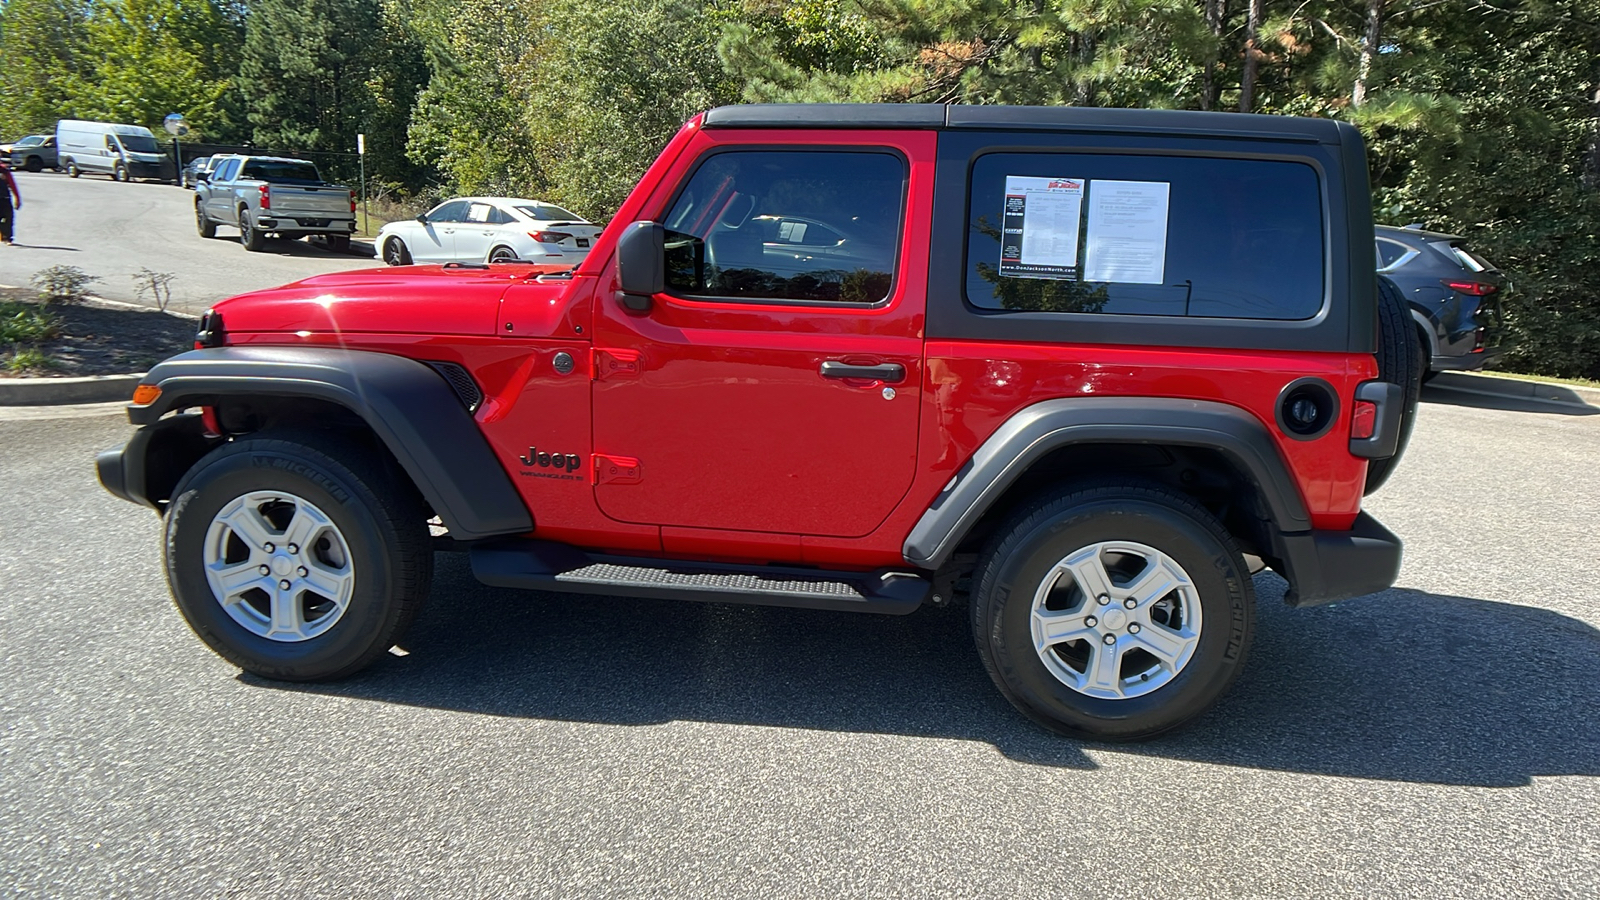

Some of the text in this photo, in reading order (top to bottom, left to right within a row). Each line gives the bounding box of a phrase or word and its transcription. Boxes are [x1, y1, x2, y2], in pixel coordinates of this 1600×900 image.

[1001, 265, 1076, 273] www.DonJacksonNorth.com
[519, 446, 581, 473] Jeep
[272, 457, 349, 503] MICHELIN
[1225, 577, 1243, 660] MICHELIN
